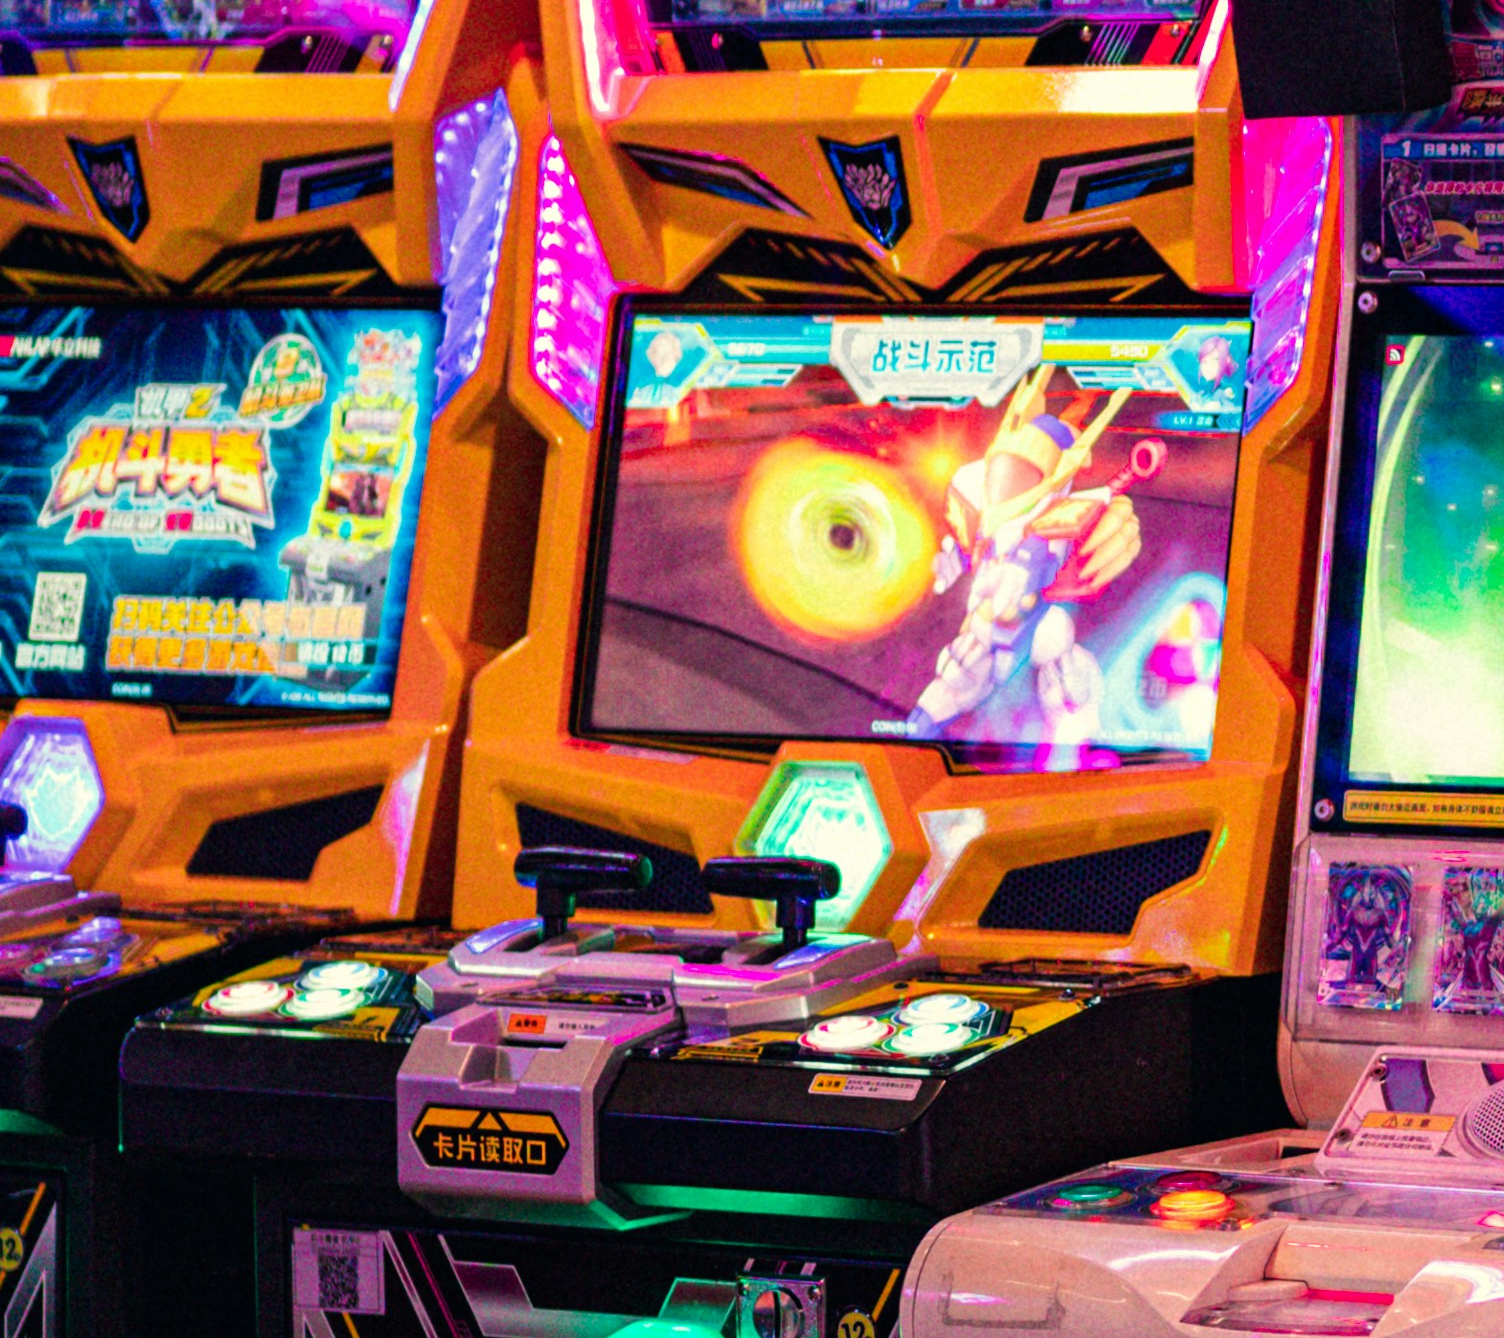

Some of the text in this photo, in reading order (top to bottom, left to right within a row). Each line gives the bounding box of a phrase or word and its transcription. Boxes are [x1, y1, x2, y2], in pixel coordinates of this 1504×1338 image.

[870, 337, 999, 375] 战斗示范
[58, 425, 268, 507] 机斗勇者
[431, 1132, 549, 1169] 卡片读取口
